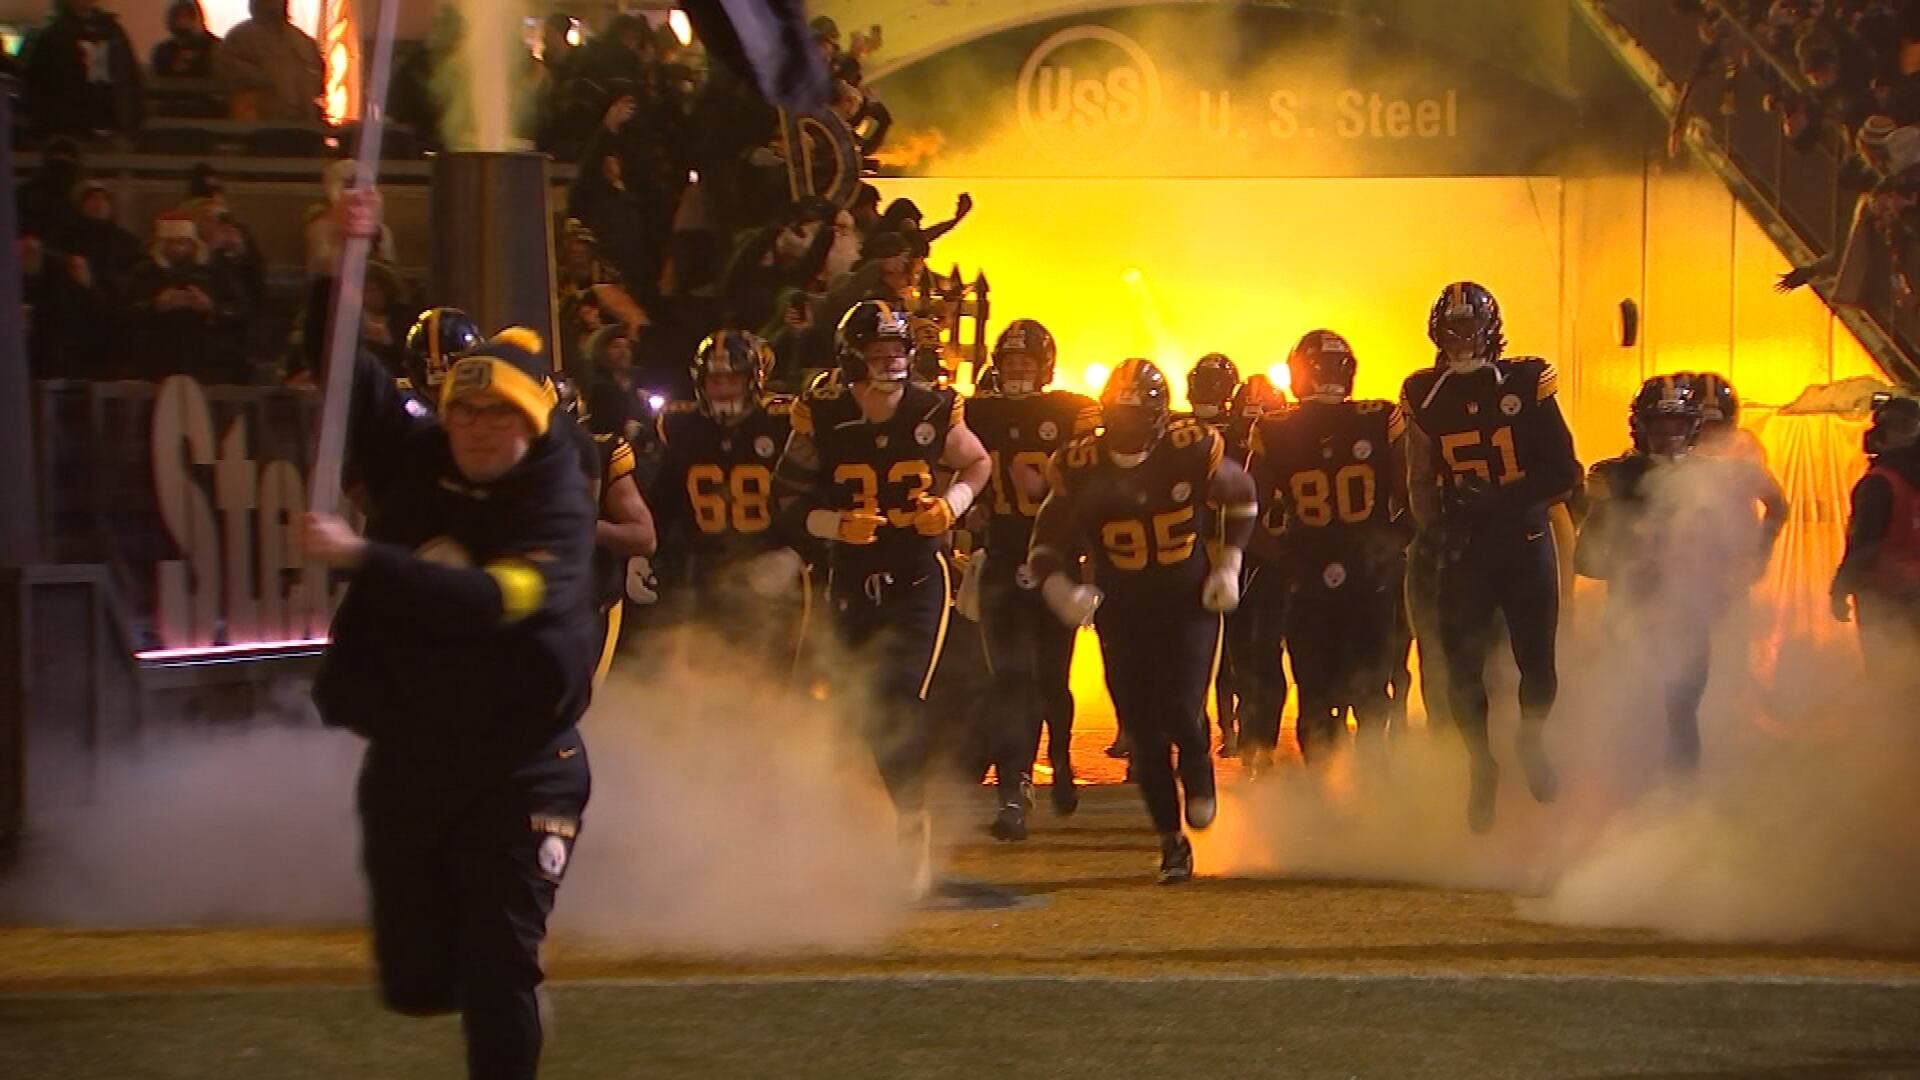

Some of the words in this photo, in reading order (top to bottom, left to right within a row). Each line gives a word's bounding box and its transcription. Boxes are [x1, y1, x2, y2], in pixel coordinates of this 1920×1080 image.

[1039, 65, 1141, 130] USS
[1336, 89, 1457, 138] Steel
[991, 450, 1056, 516] 10
[1440, 426, 1526, 487] 51
[687, 464, 771, 534] 68
[834, 460, 933, 529] 33
[1290, 463, 1376, 527] 80
[1102, 505, 1197, 571] 95
